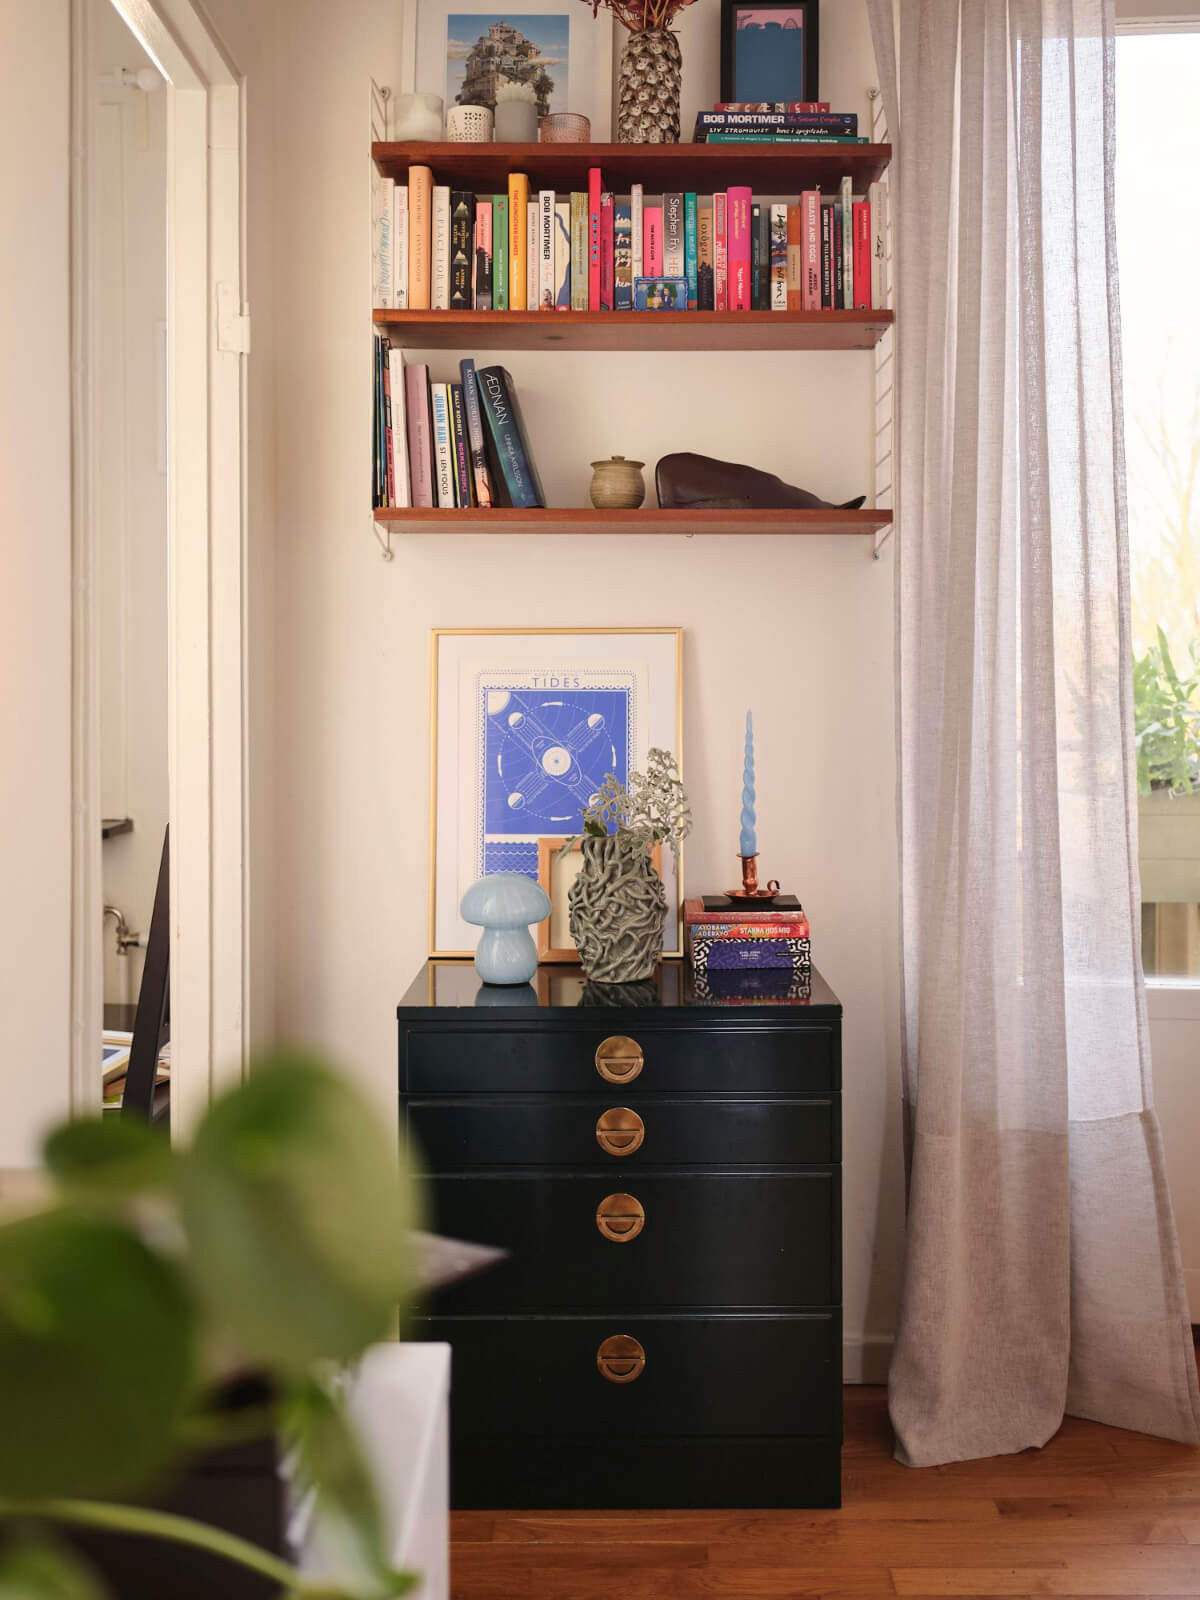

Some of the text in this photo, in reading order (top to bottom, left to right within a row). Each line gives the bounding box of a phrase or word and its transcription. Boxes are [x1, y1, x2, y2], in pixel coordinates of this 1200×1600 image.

[703, 114, 725, 123] BOB
[728, 115, 785, 124] MORTIMER
[667, 198, 680, 237] Stephen
[808, 196, 816, 225] BREASTS
[668, 238, 680, 251] Fry
[437, 286, 444, 300] US
[466, 368, 474, 395] ROMAN
[434, 394, 446, 423] JOHANN
[468, 397, 476, 426] STORIES
[436, 426, 447, 445] HARI
[484, 374, 509, 425] ÆDNAN
[509, 456, 523, 488] AXELSSON
[458, 442, 466, 468] NORMAL
[532, 678, 580, 688] TIDES
[778, 926, 790, 934] MIG
